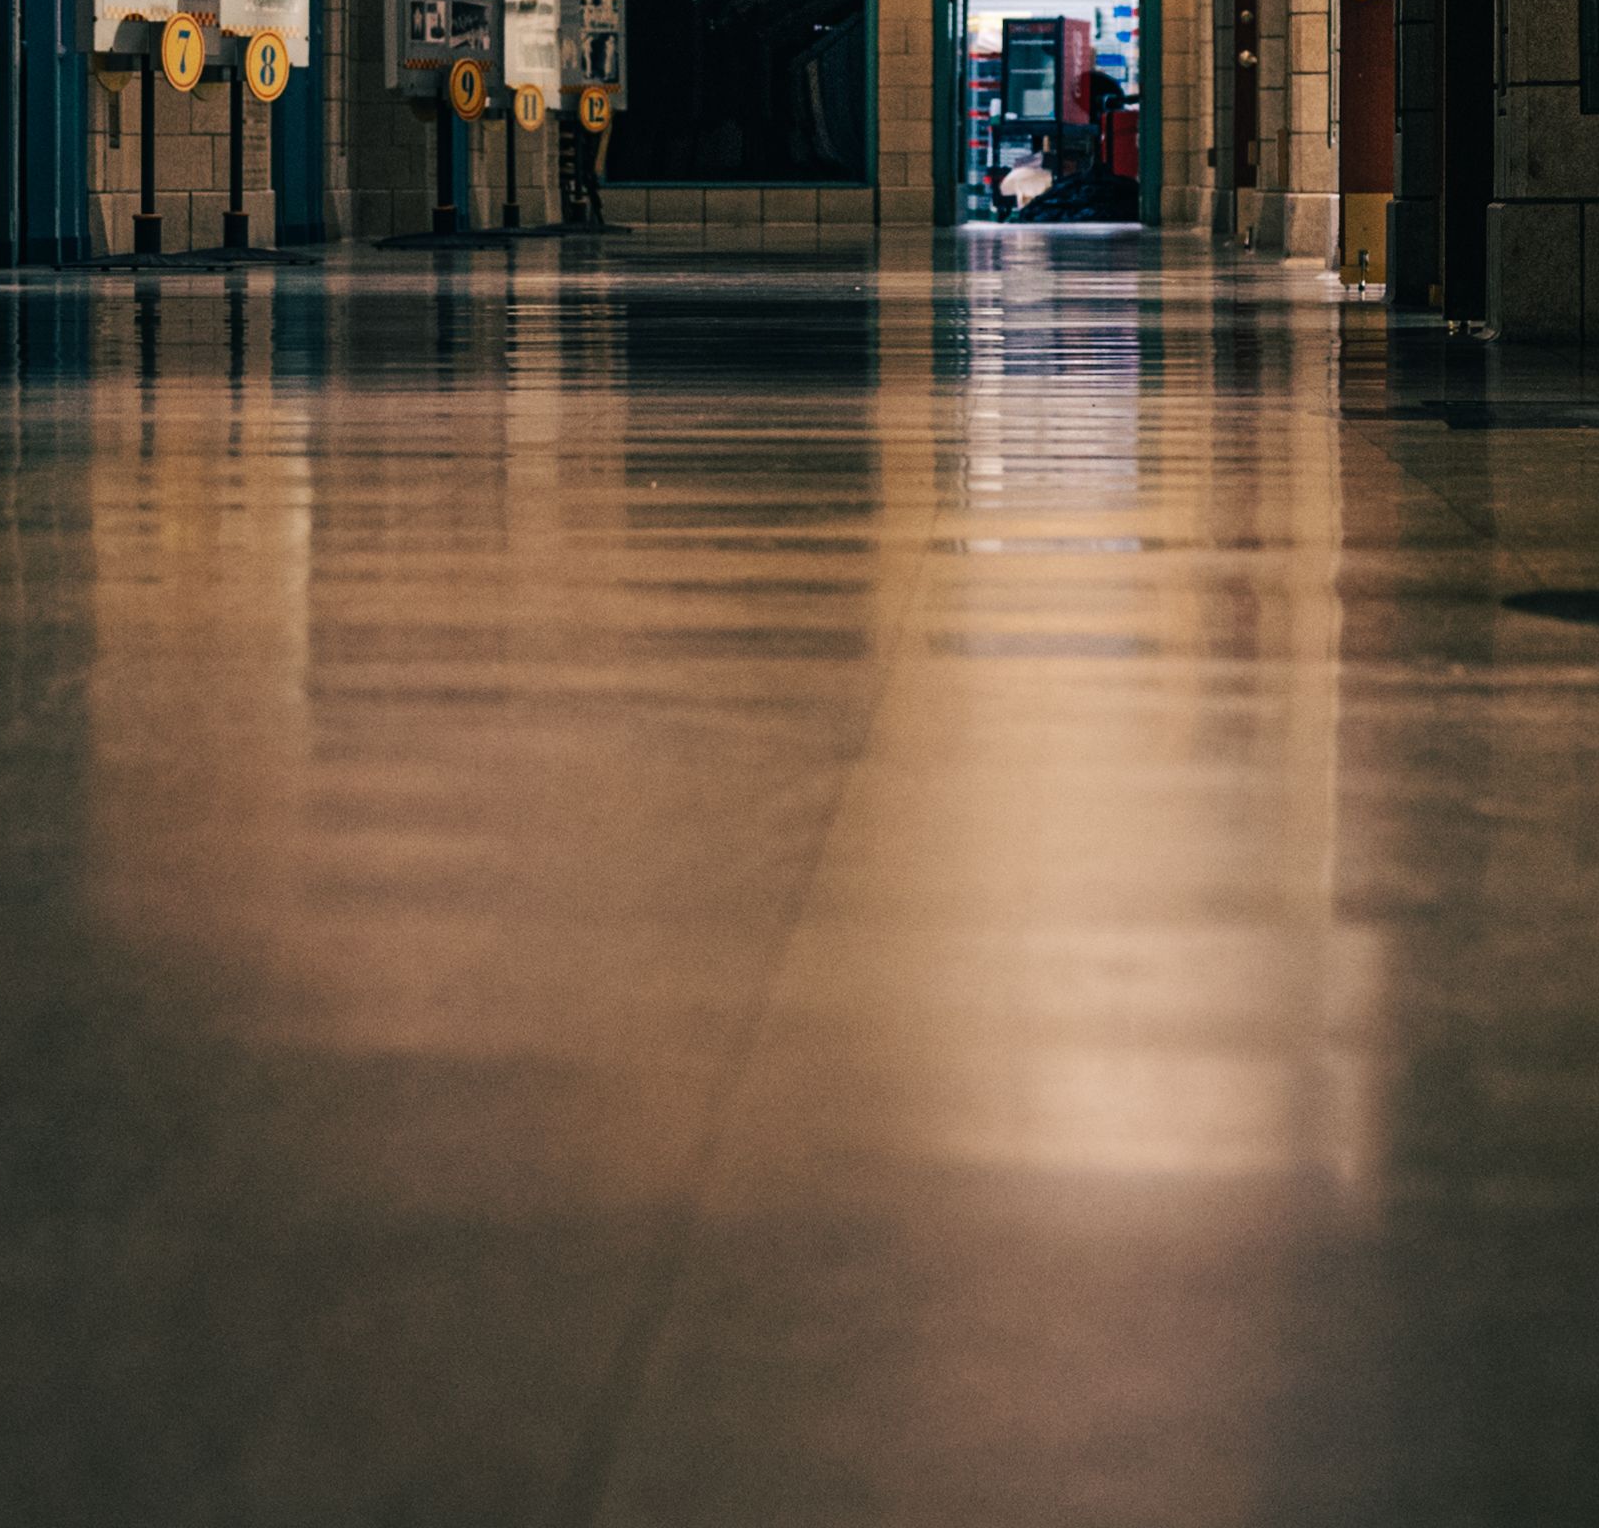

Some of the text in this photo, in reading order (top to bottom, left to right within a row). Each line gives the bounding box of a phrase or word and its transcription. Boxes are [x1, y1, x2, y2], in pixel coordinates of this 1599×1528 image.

[178, 30, 191, 74] 7
[261, 44, 275, 87] 8
[462, 71, 474, 106] 9
[523, 93, 539, 121] 11
[589, 96, 605, 122] 12
